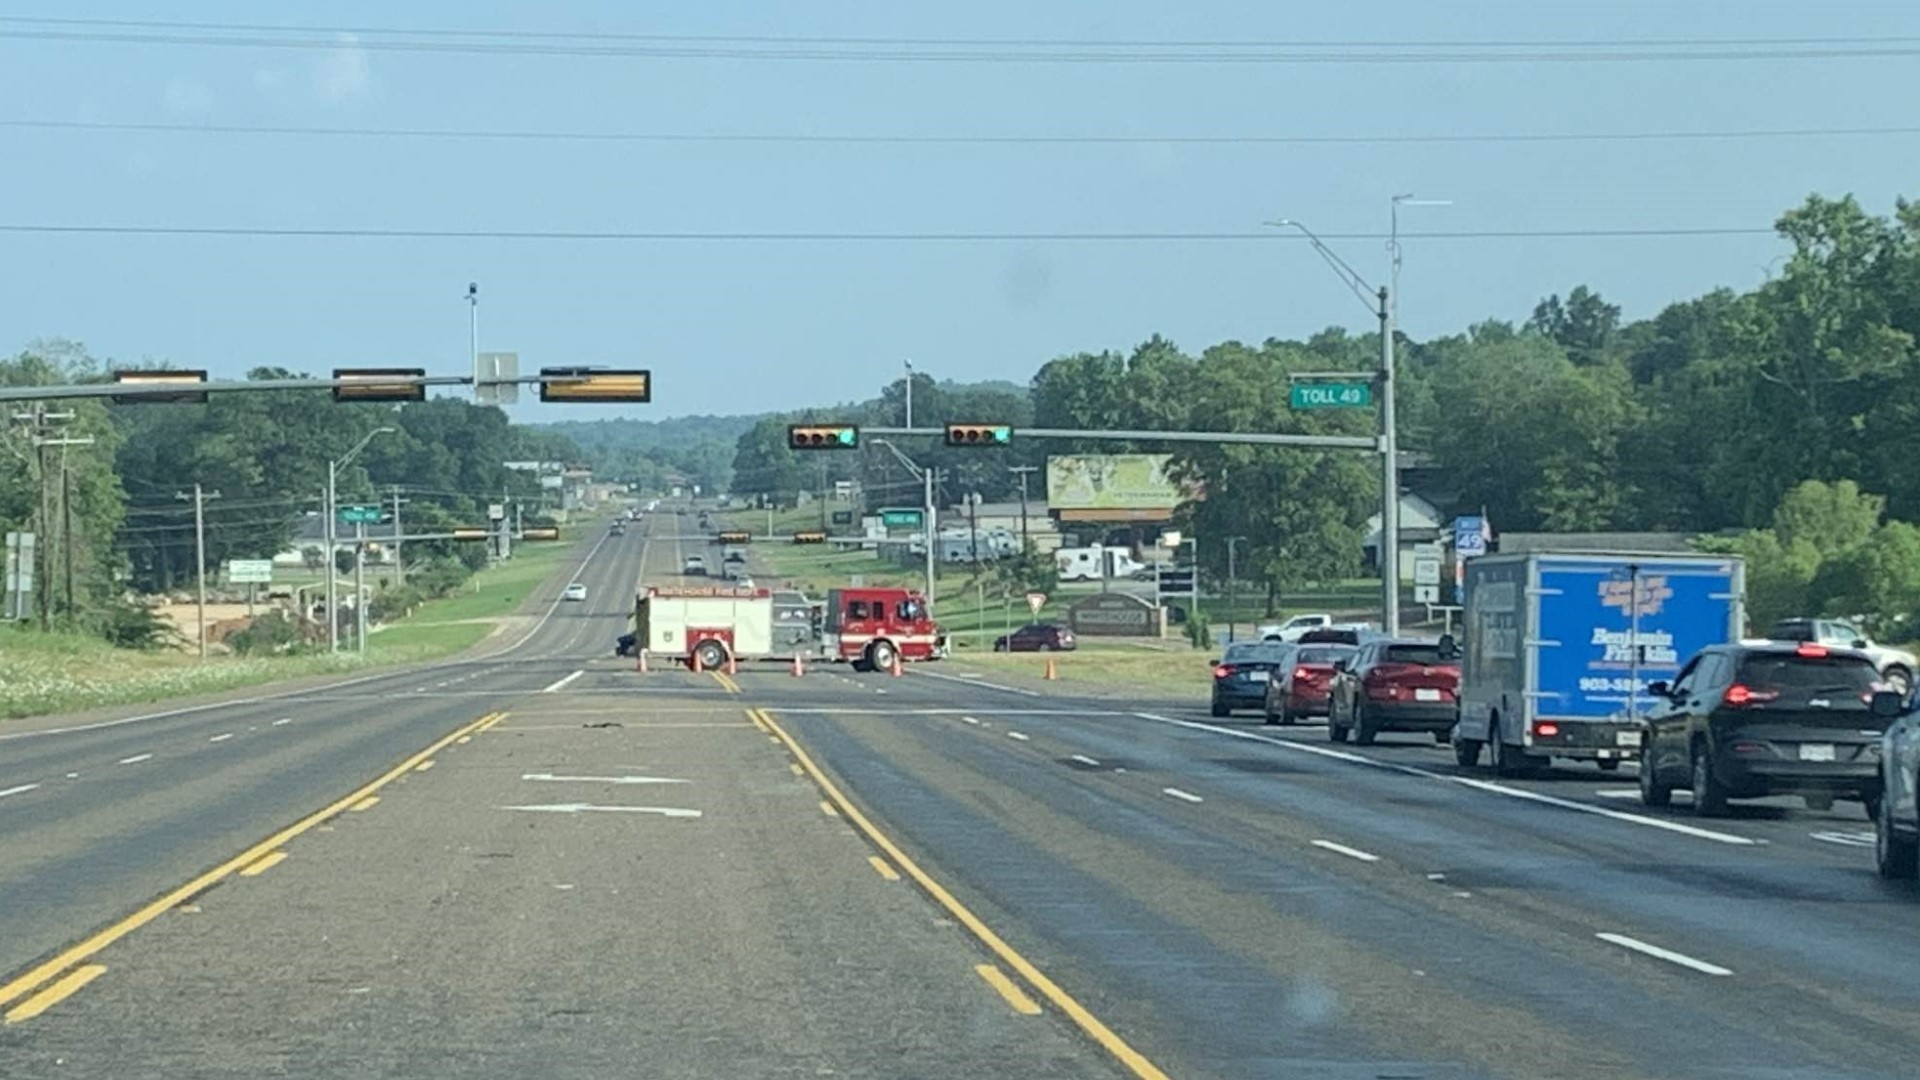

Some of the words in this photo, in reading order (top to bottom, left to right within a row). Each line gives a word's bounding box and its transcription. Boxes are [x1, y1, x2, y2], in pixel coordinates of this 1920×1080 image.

[1301, 389, 1335, 403] TOLL
[1340, 388, 1361, 403] 49
[1459, 534, 1480, 549] 49
[1591, 628, 1672, 648] Benjamin
